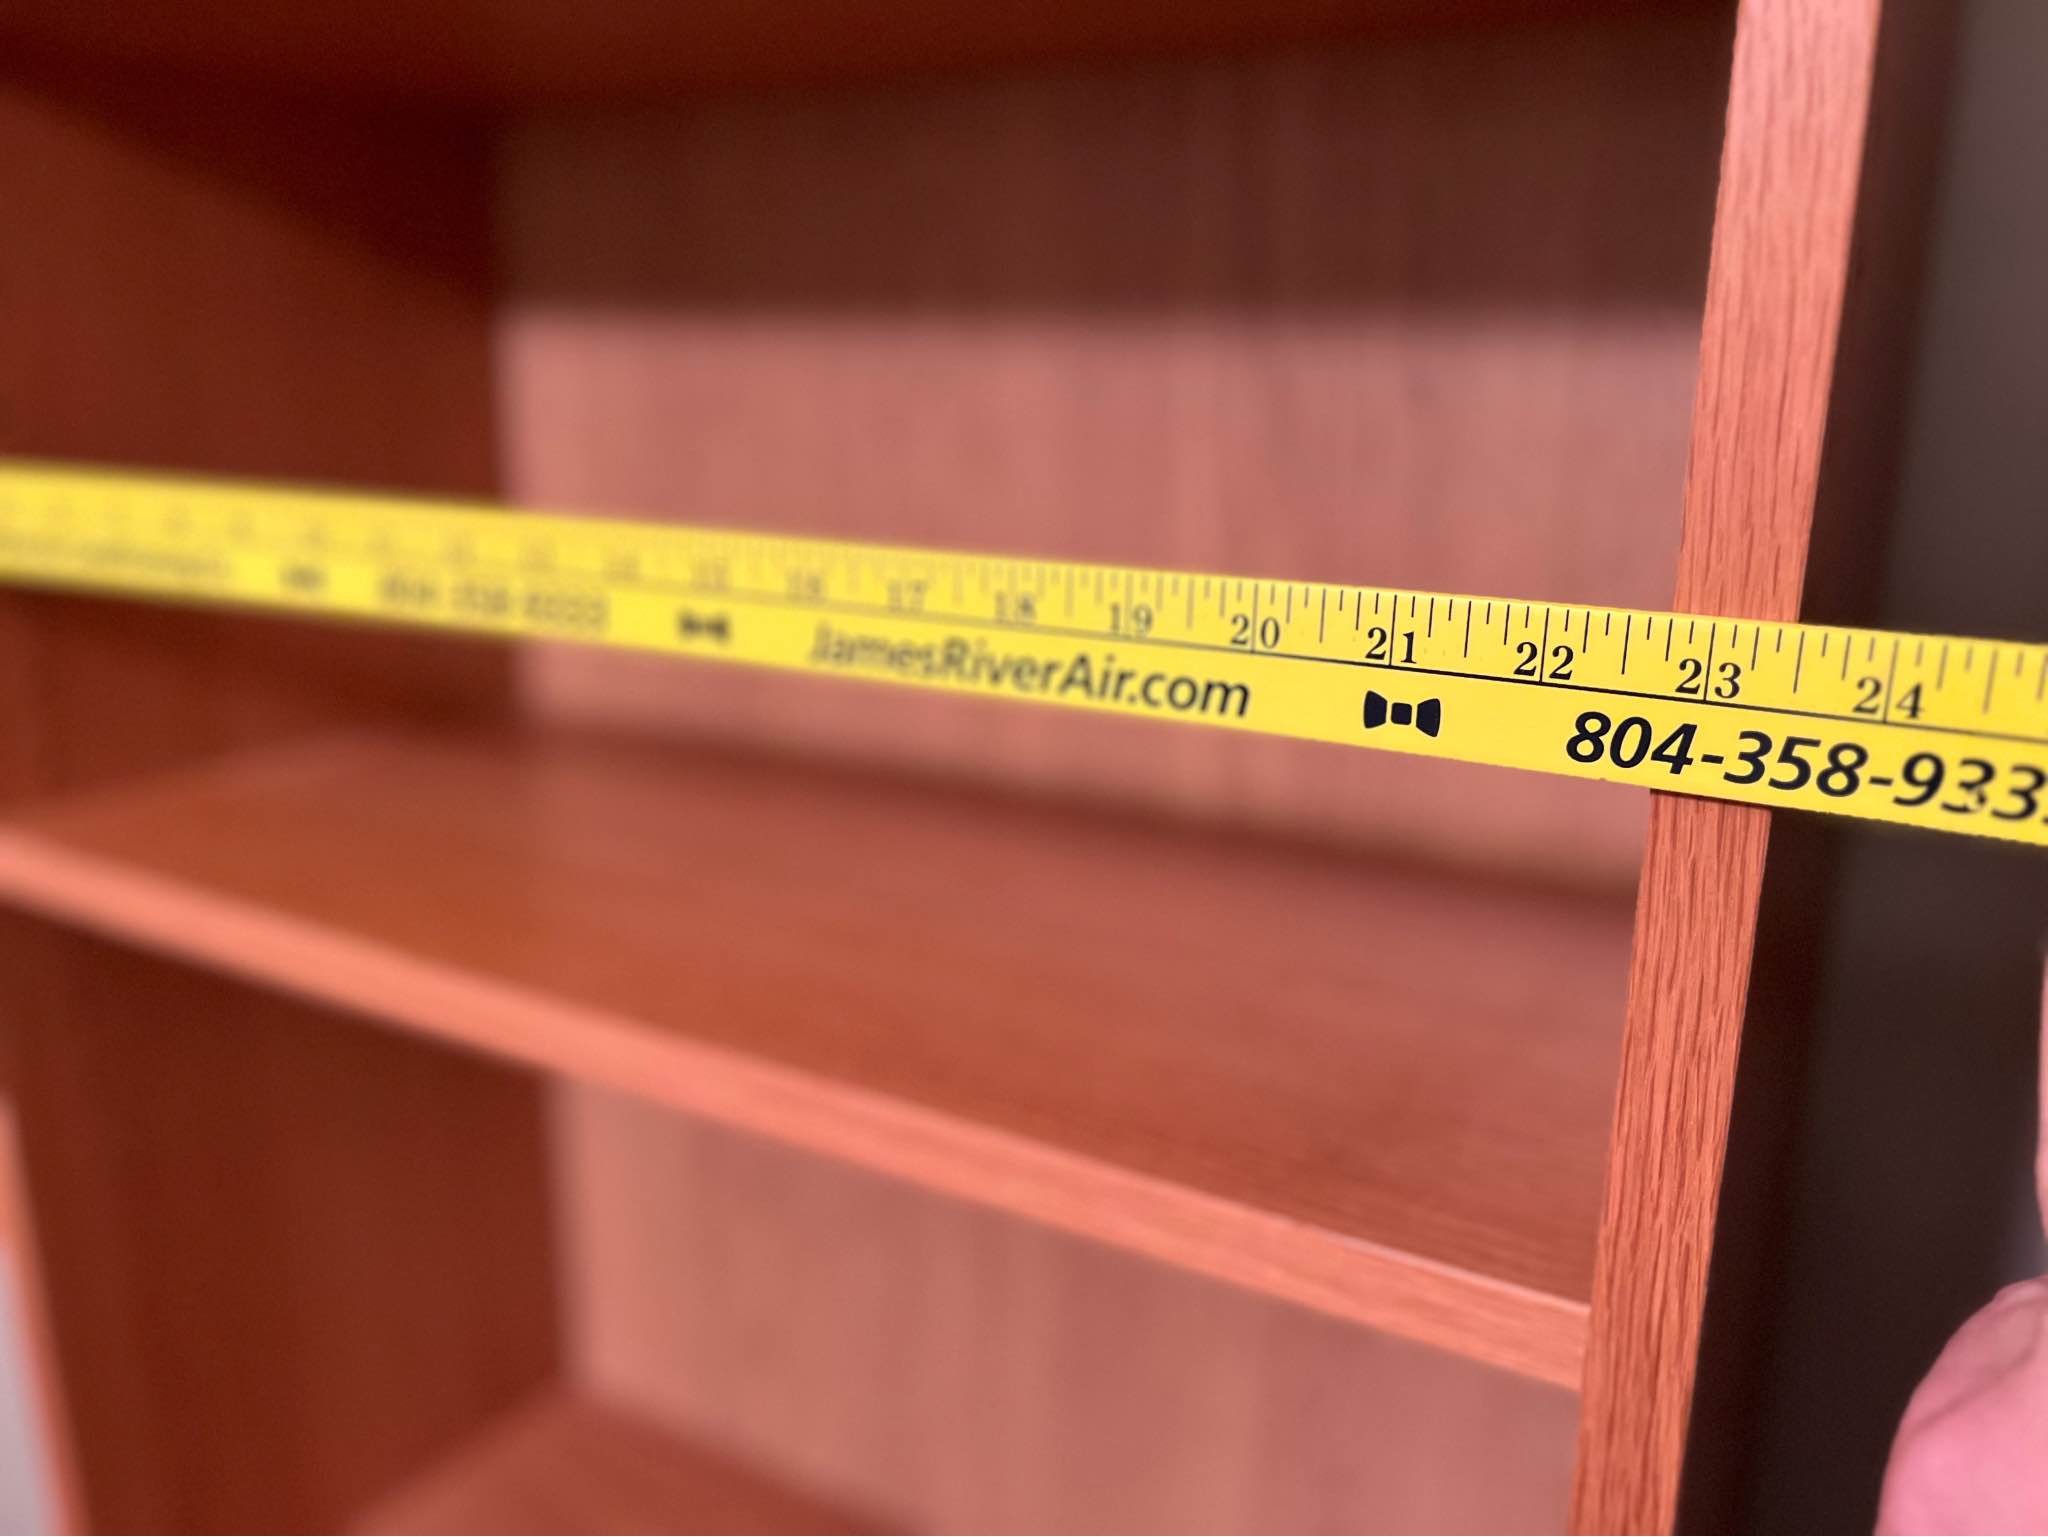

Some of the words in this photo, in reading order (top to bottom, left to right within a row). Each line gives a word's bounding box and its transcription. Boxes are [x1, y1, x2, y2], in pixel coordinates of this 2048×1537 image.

[809, 621, 1251, 718] JamesRiverAir.com
[887, 580, 927, 613] 17
[993, 593, 1037, 625] 18
[1109, 602, 1154, 638] 19
[1230, 614, 1281, 649] 20
[1365, 626, 1418, 664] 21
[1513, 641, 1574, 680] 22
[1674, 657, 1742, 699] 23
[1852, 676, 1925, 720] 24
[1565, 710, 2048, 826] 804-358-933
